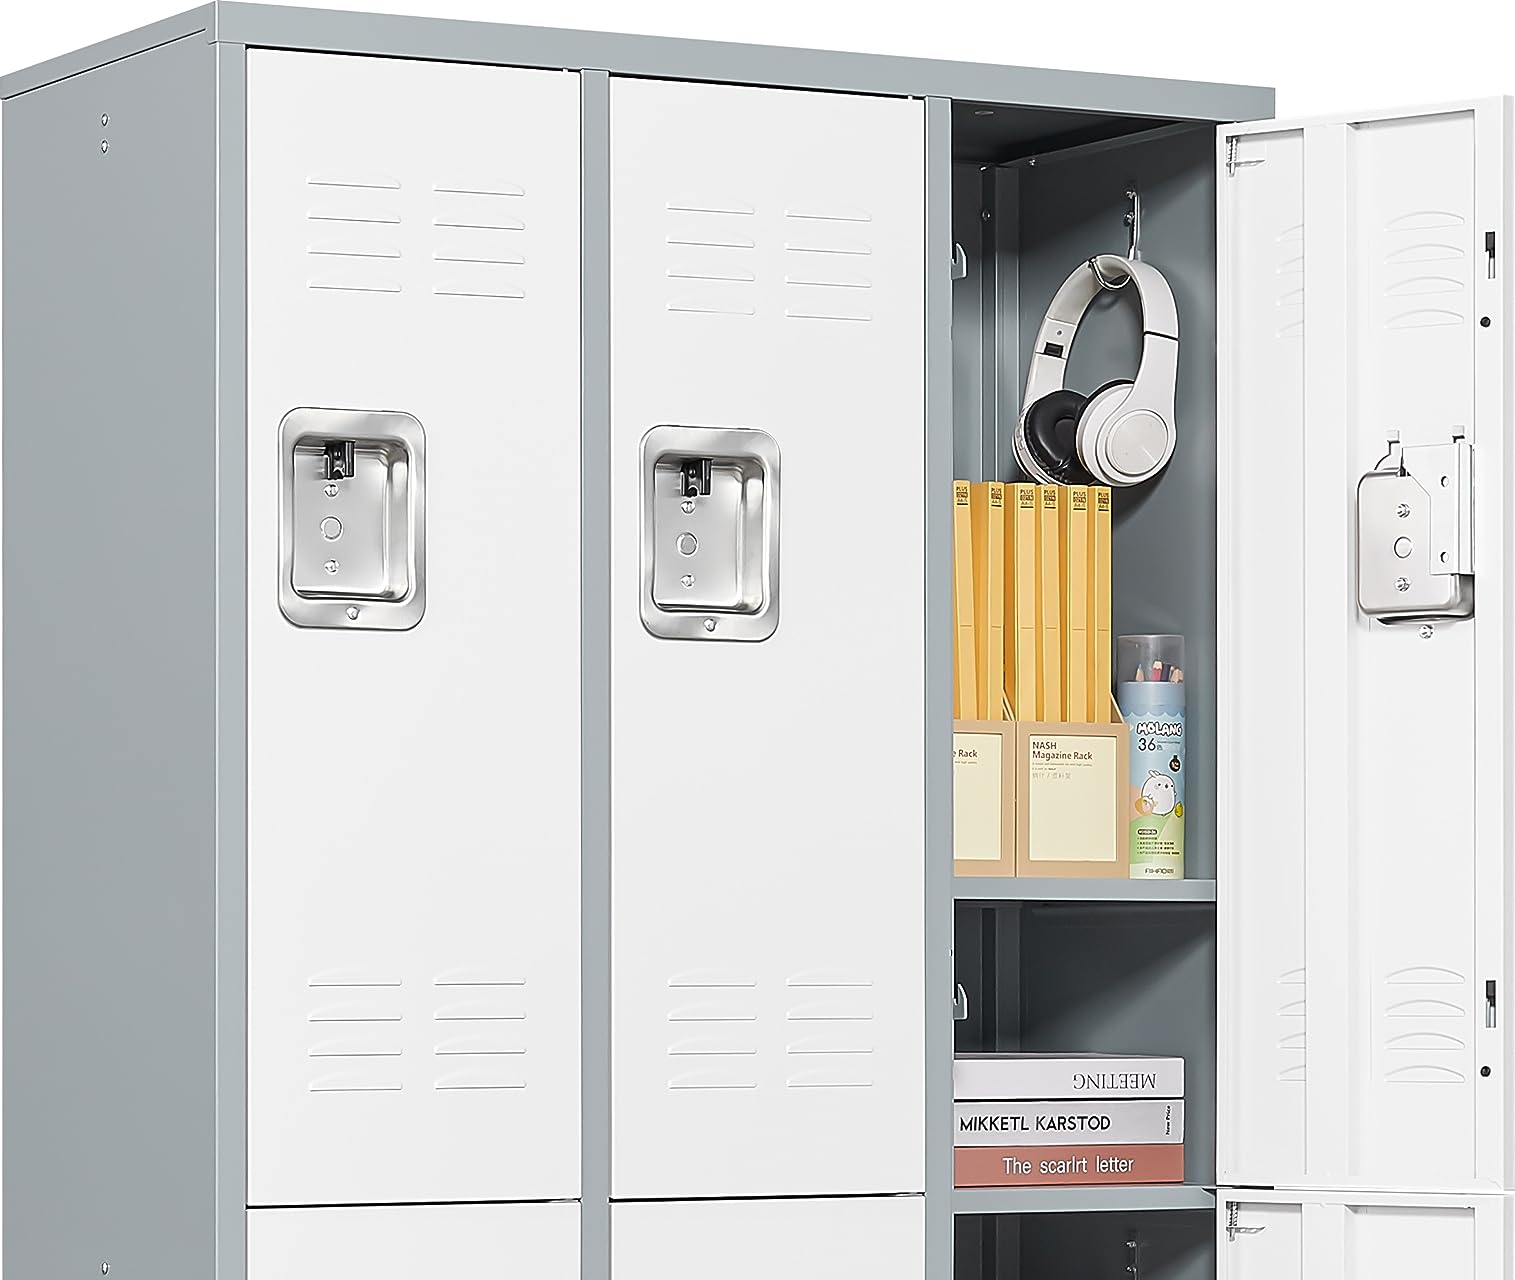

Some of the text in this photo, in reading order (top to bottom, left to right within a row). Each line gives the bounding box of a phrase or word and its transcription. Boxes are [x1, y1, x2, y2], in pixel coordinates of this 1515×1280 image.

[1136, 721, 1183, 737] MOLANG
[1032, 741, 1057, 750] NASH
[1138, 737, 1156, 751] 36
[958, 749, 978, 758] Rack
[1032, 751, 1093, 761] Magazine Rack
[1073, 1073, 1156, 1089] MEETING
[960, 1116, 1111, 1131] MIKKETL KARSTOD
[1002, 1155, 1134, 1175] The scarlrt letter
